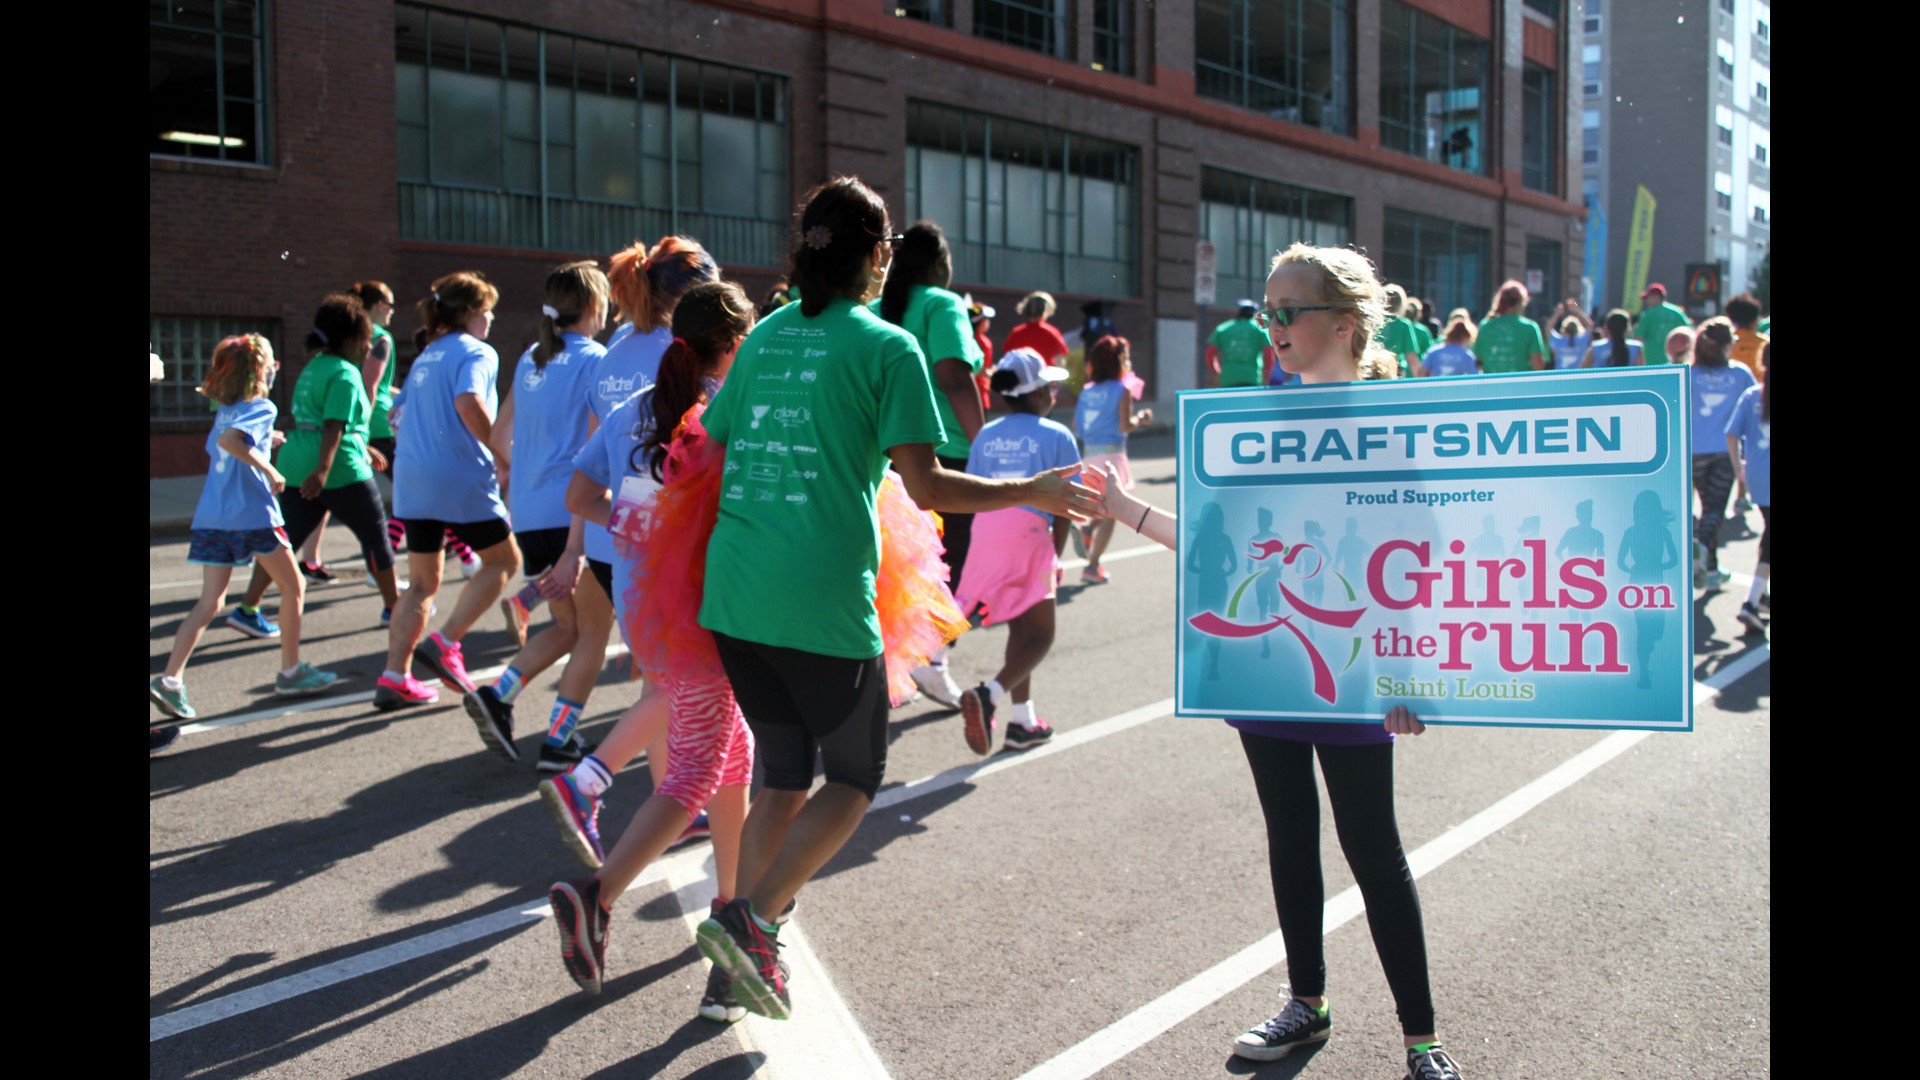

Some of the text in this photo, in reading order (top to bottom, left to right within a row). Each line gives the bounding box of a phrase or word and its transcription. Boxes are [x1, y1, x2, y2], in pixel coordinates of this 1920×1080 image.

[1230, 416, 1621, 464] CRAFTSMEN
[1346, 488, 1495, 507] Proud Supporter
[610, 506, 662, 543] 13
[1366, 539, 1675, 610] Girls on
[1372, 621, 1629, 673] the run
[1376, 676, 1535, 699] Saint Louis
